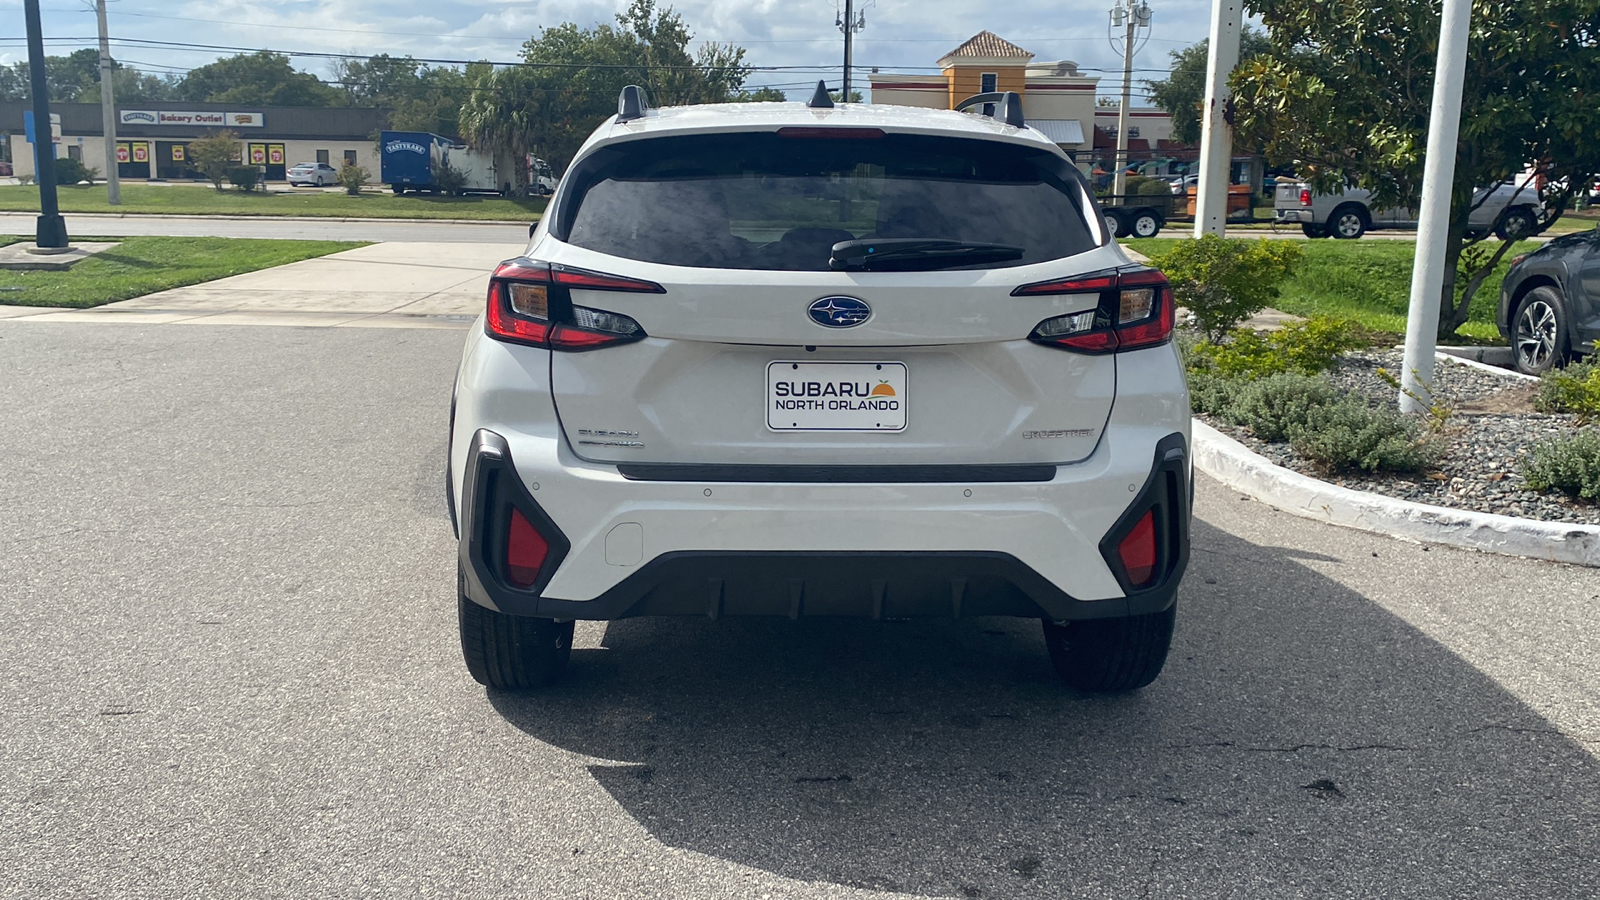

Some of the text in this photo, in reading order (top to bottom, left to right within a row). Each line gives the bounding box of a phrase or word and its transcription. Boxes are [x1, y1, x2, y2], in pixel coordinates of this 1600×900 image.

[160, 114, 223, 123] Bakery Outlet
[775, 381, 870, 397] SUBARU
[775, 400, 899, 411] NORTH ORLANDO
